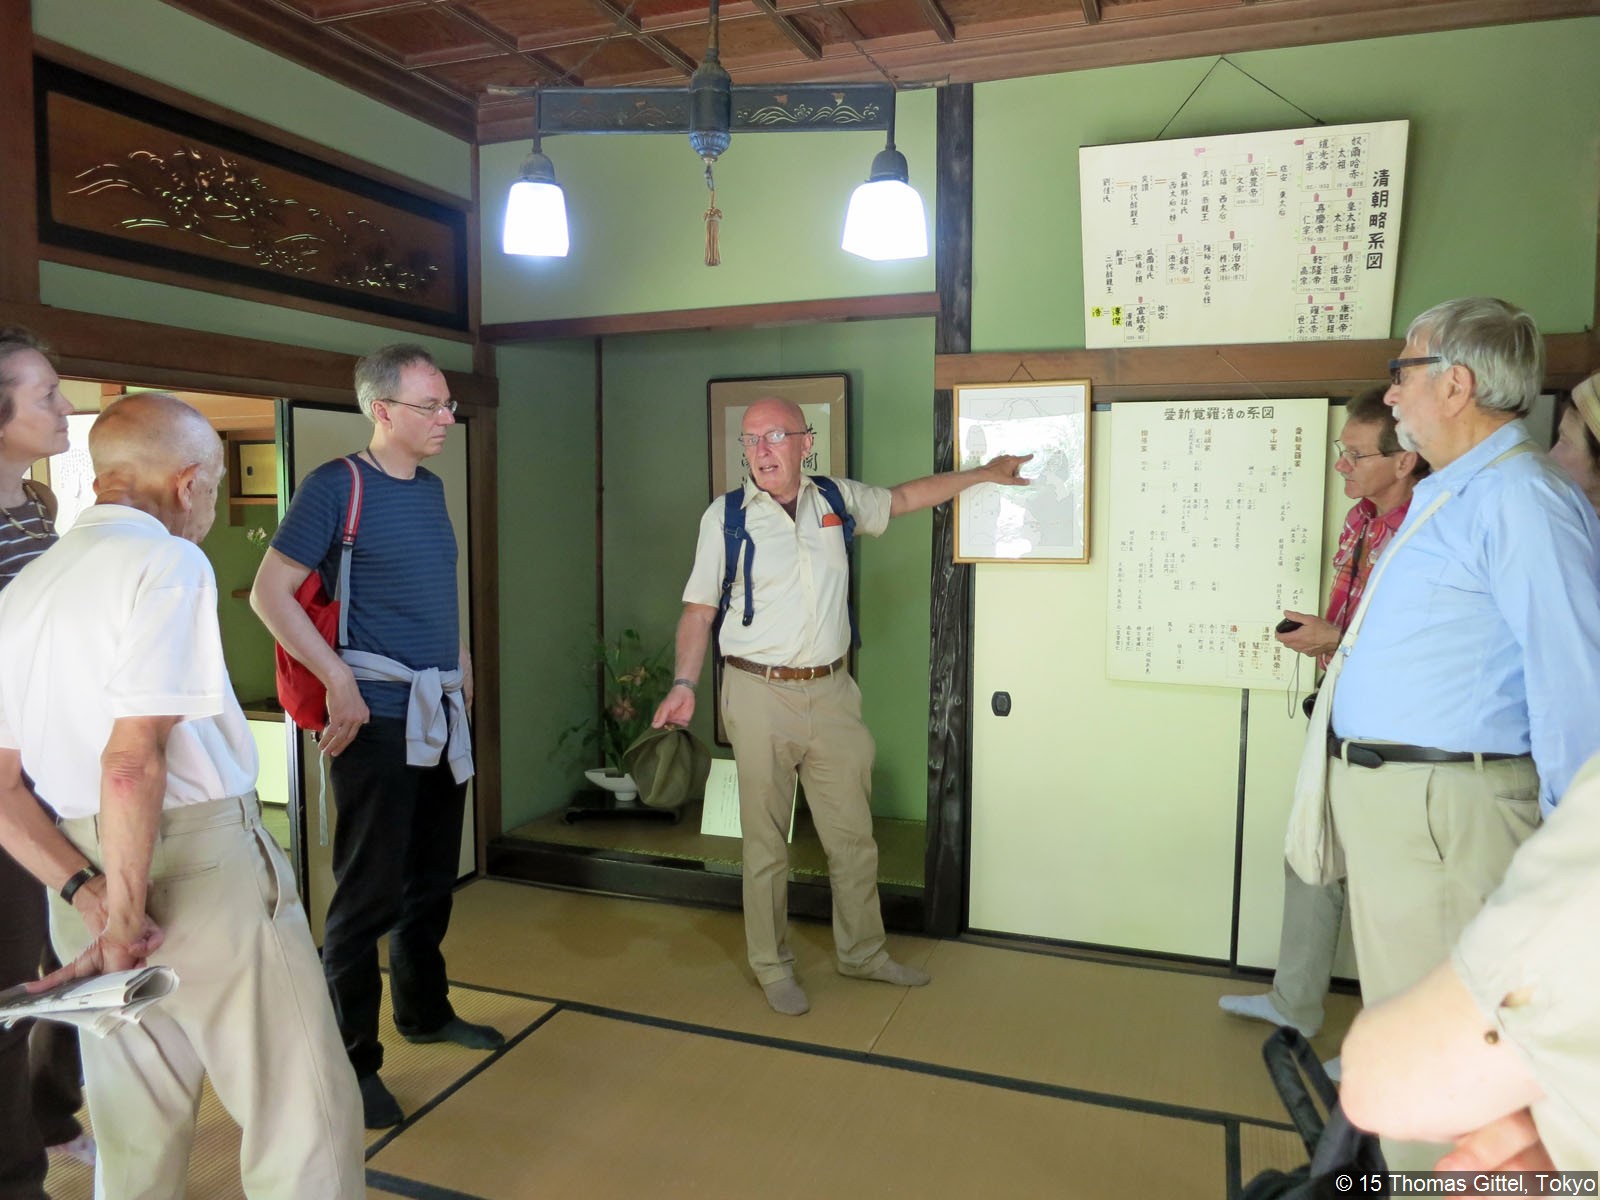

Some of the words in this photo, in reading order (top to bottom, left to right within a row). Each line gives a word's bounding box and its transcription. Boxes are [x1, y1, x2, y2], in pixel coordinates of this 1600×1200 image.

[1365, 168, 1390, 270] 清朝略系図
[1164, 406, 1274, 421] 愛新覚羅浩の系図
